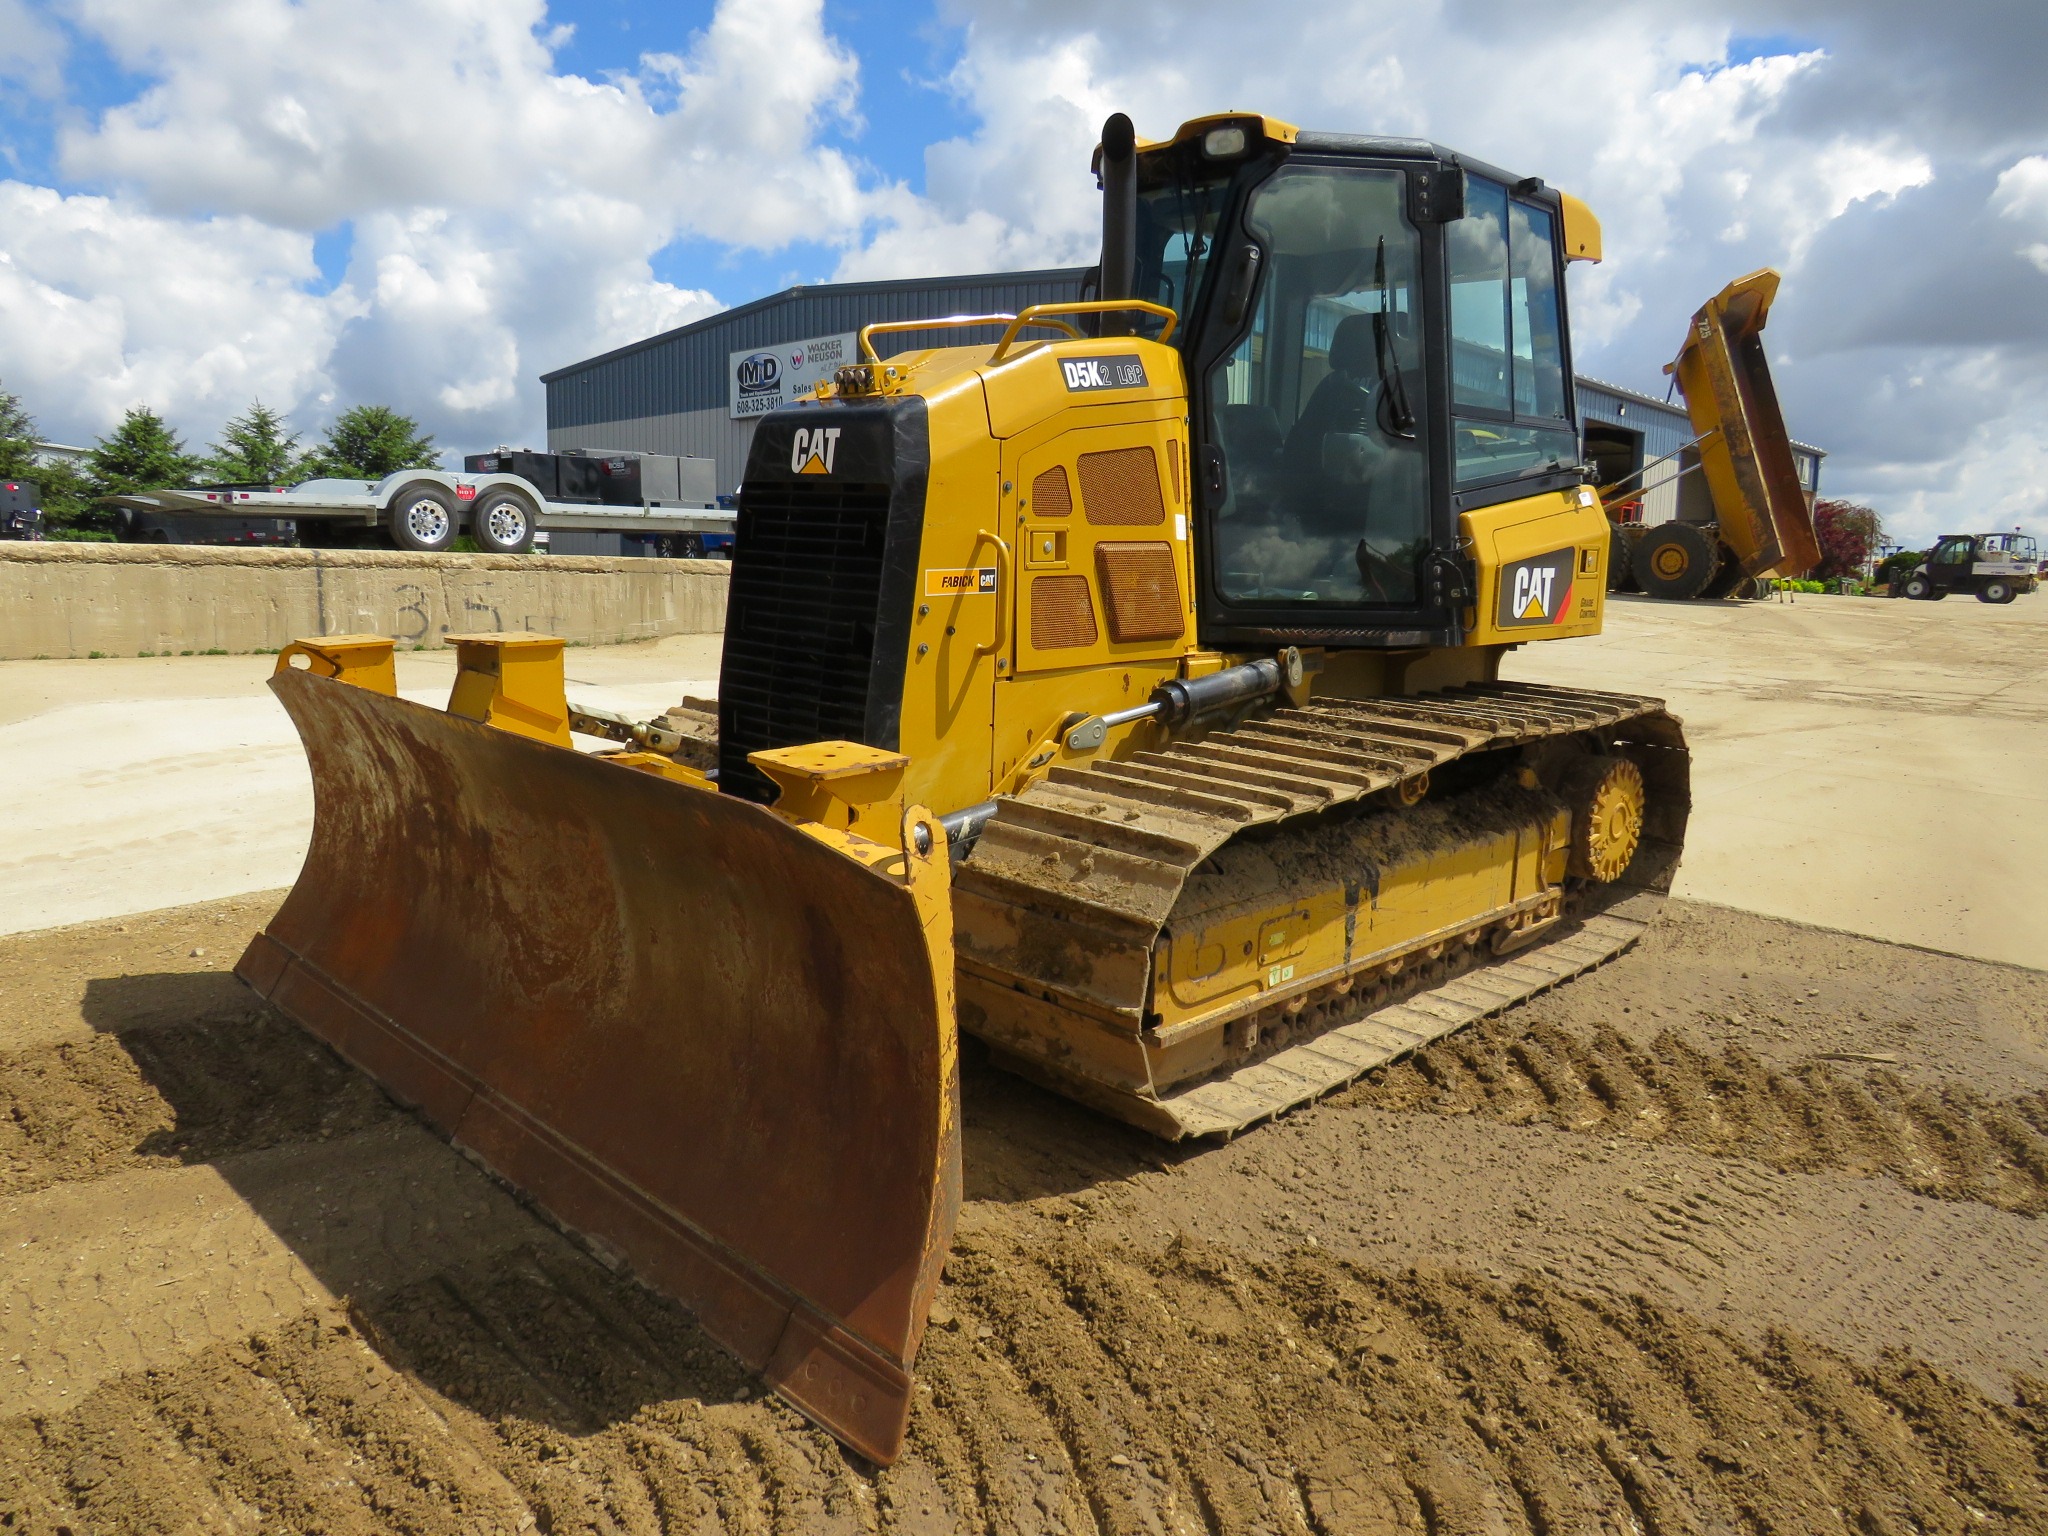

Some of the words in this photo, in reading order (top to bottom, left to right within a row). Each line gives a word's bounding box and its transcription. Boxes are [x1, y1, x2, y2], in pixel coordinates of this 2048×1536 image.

[1698, 318, 1711, 338] 725
[807, 340, 842, 354] WACKER
[807, 350, 843, 363] NEUSON
[1116, 365, 1143, 385] LGP
[737, 396, 783, 413] 608-325-3810
[791, 428, 841, 474] CAT
[941, 576, 975, 588] FABICK
[980, 575, 995, 587] CAT
[1513, 566, 1556, 619] CAT
